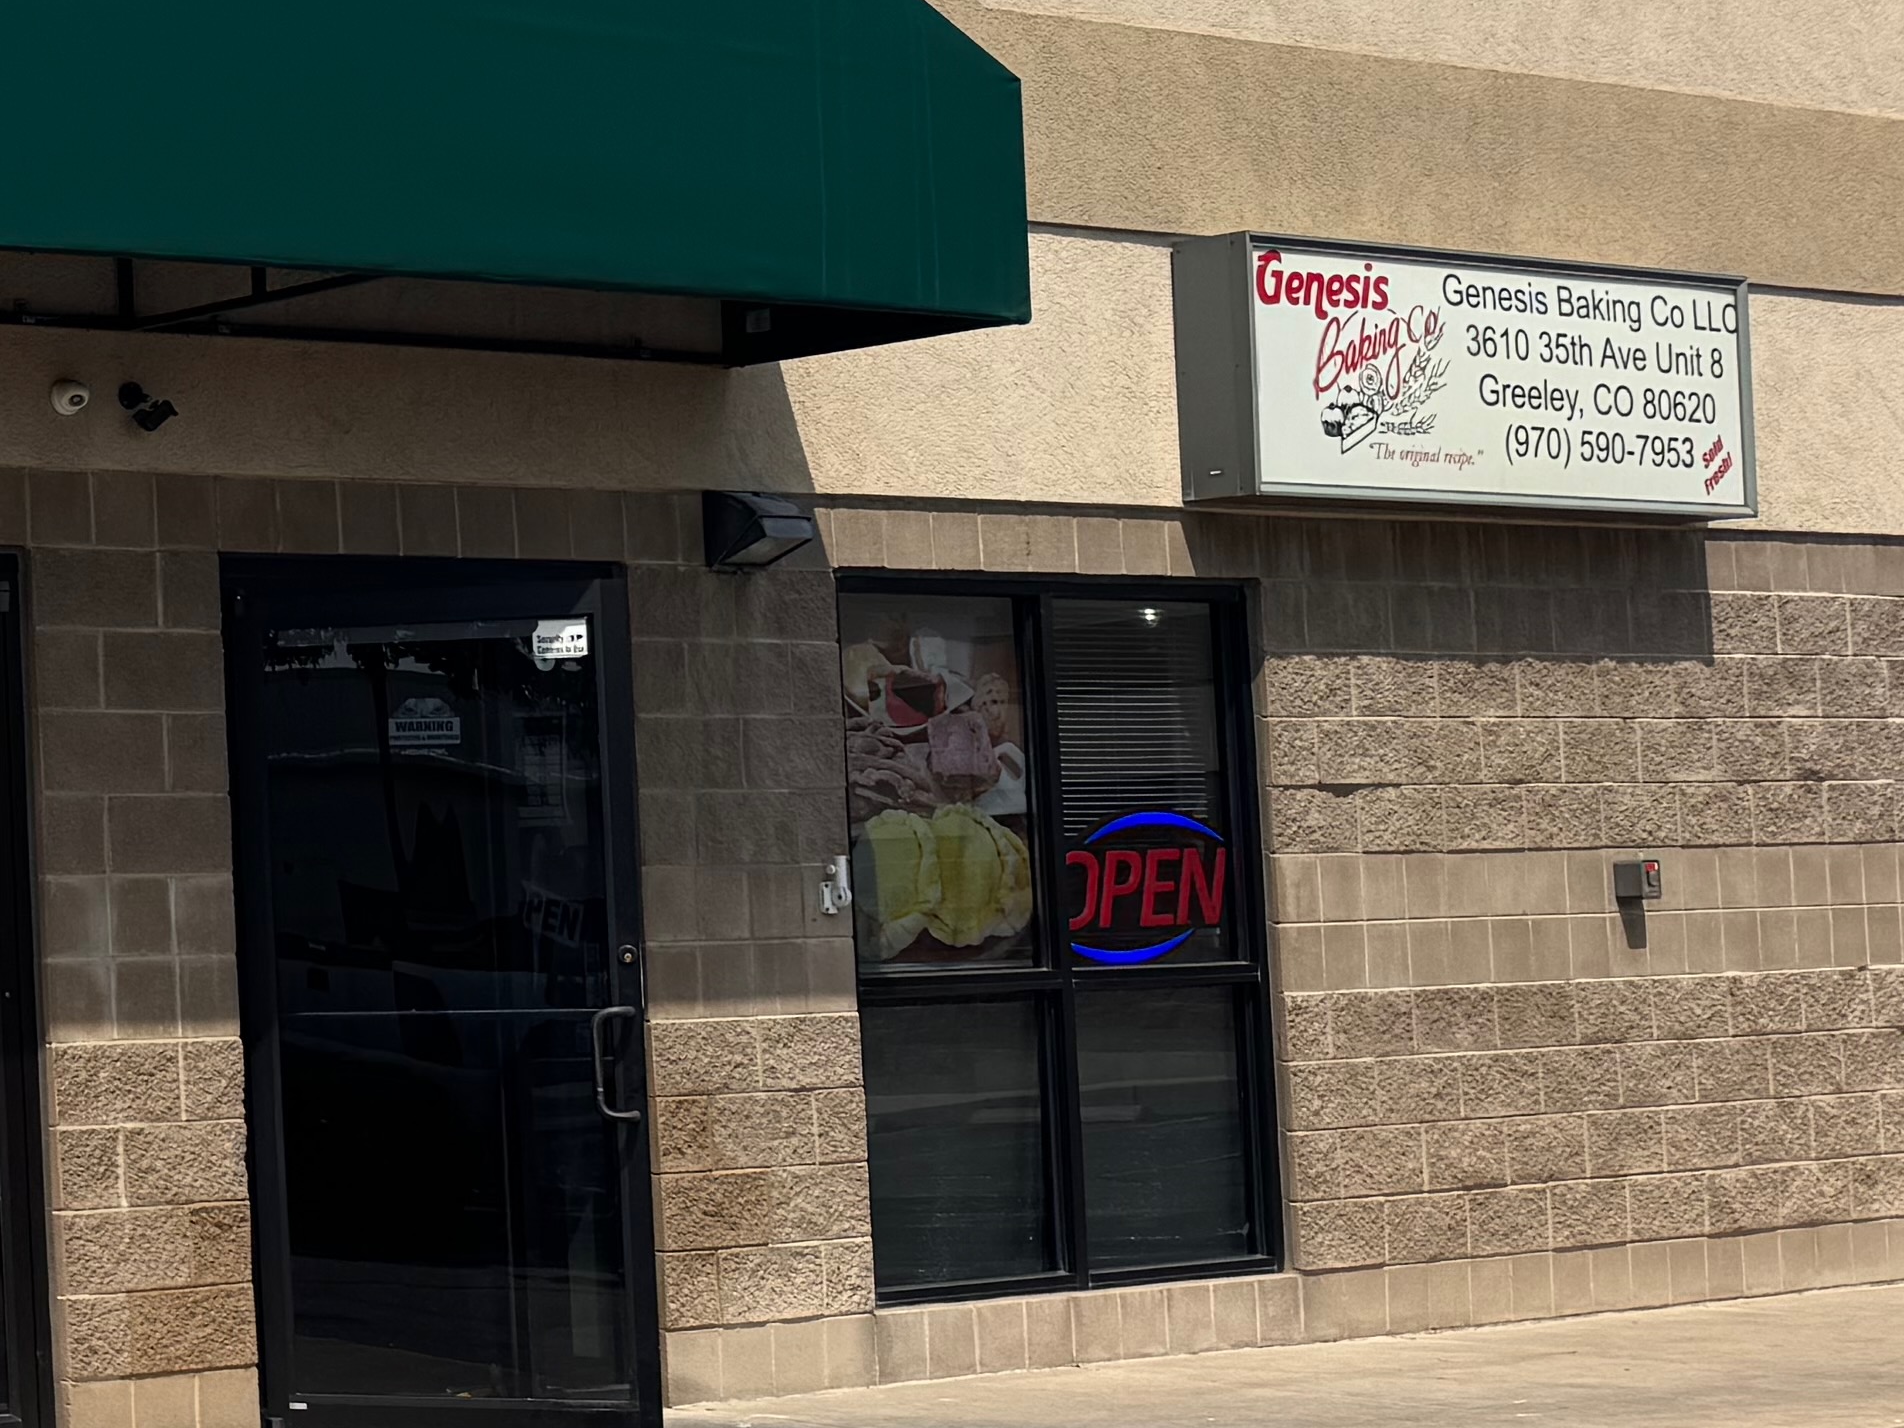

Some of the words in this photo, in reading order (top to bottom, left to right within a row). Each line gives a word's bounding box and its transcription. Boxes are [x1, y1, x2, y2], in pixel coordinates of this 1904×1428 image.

[1255, 249, 1390, 320] Genesis
[1441, 273, 1549, 316] Genesis
[1556, 285, 1642, 333] Baking
[1650, 295, 1685, 330] Co
[1312, 315, 1407, 401] Baking
[1465, 323, 1530, 362] 3610
[1538, 330, 1594, 368] 35th
[1600, 336, 1648, 373] Ave
[1655, 341, 1704, 378] Unit
[1710, 347, 1725, 380] 8
[1478, 373, 1584, 421] Greeley,
[1593, 383, 1635, 418] CO
[1642, 387, 1717, 425] 80620
[1399, 443, 1442, 469] original
[1505, 423, 1572, 470] (970)
[1579, 429, 1695, 469] 590-7953
[1702, 433, 1724, 469] Sold
[394, 720, 454, 733] WARNING
